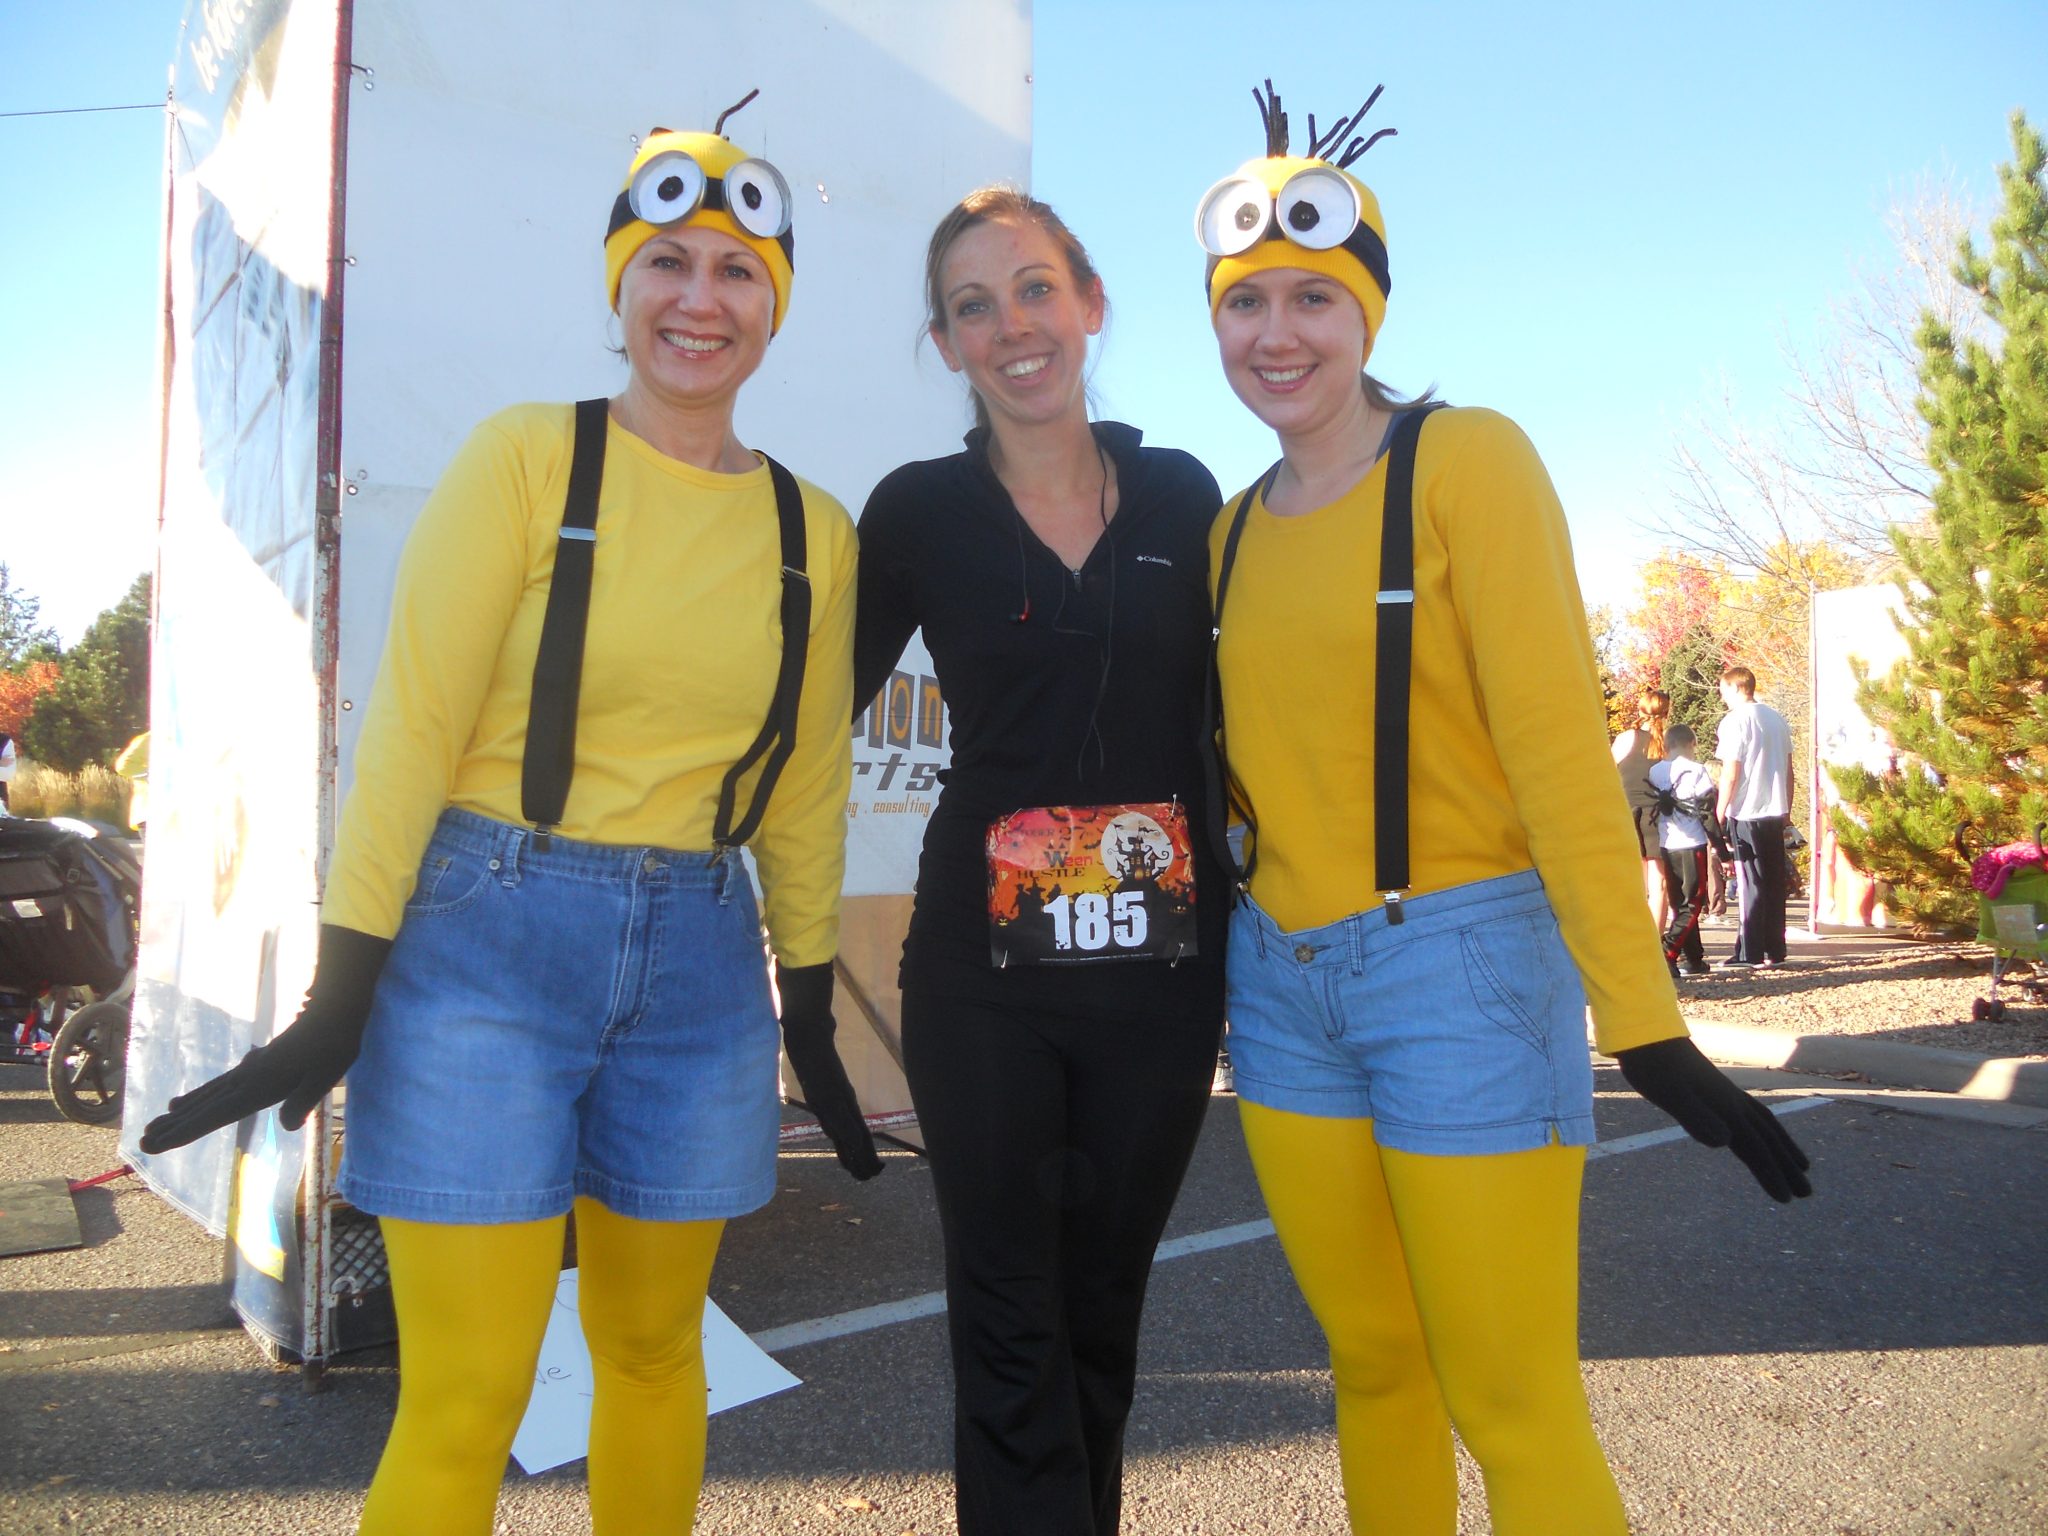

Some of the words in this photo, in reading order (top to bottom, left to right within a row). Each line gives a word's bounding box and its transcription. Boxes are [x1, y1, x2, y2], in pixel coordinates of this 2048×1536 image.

[870, 674, 943, 744] ion
[873, 793, 931, 818] consulting
[1016, 868, 1085, 880] HUSTLE
[1043, 891, 1148, 950] 185
